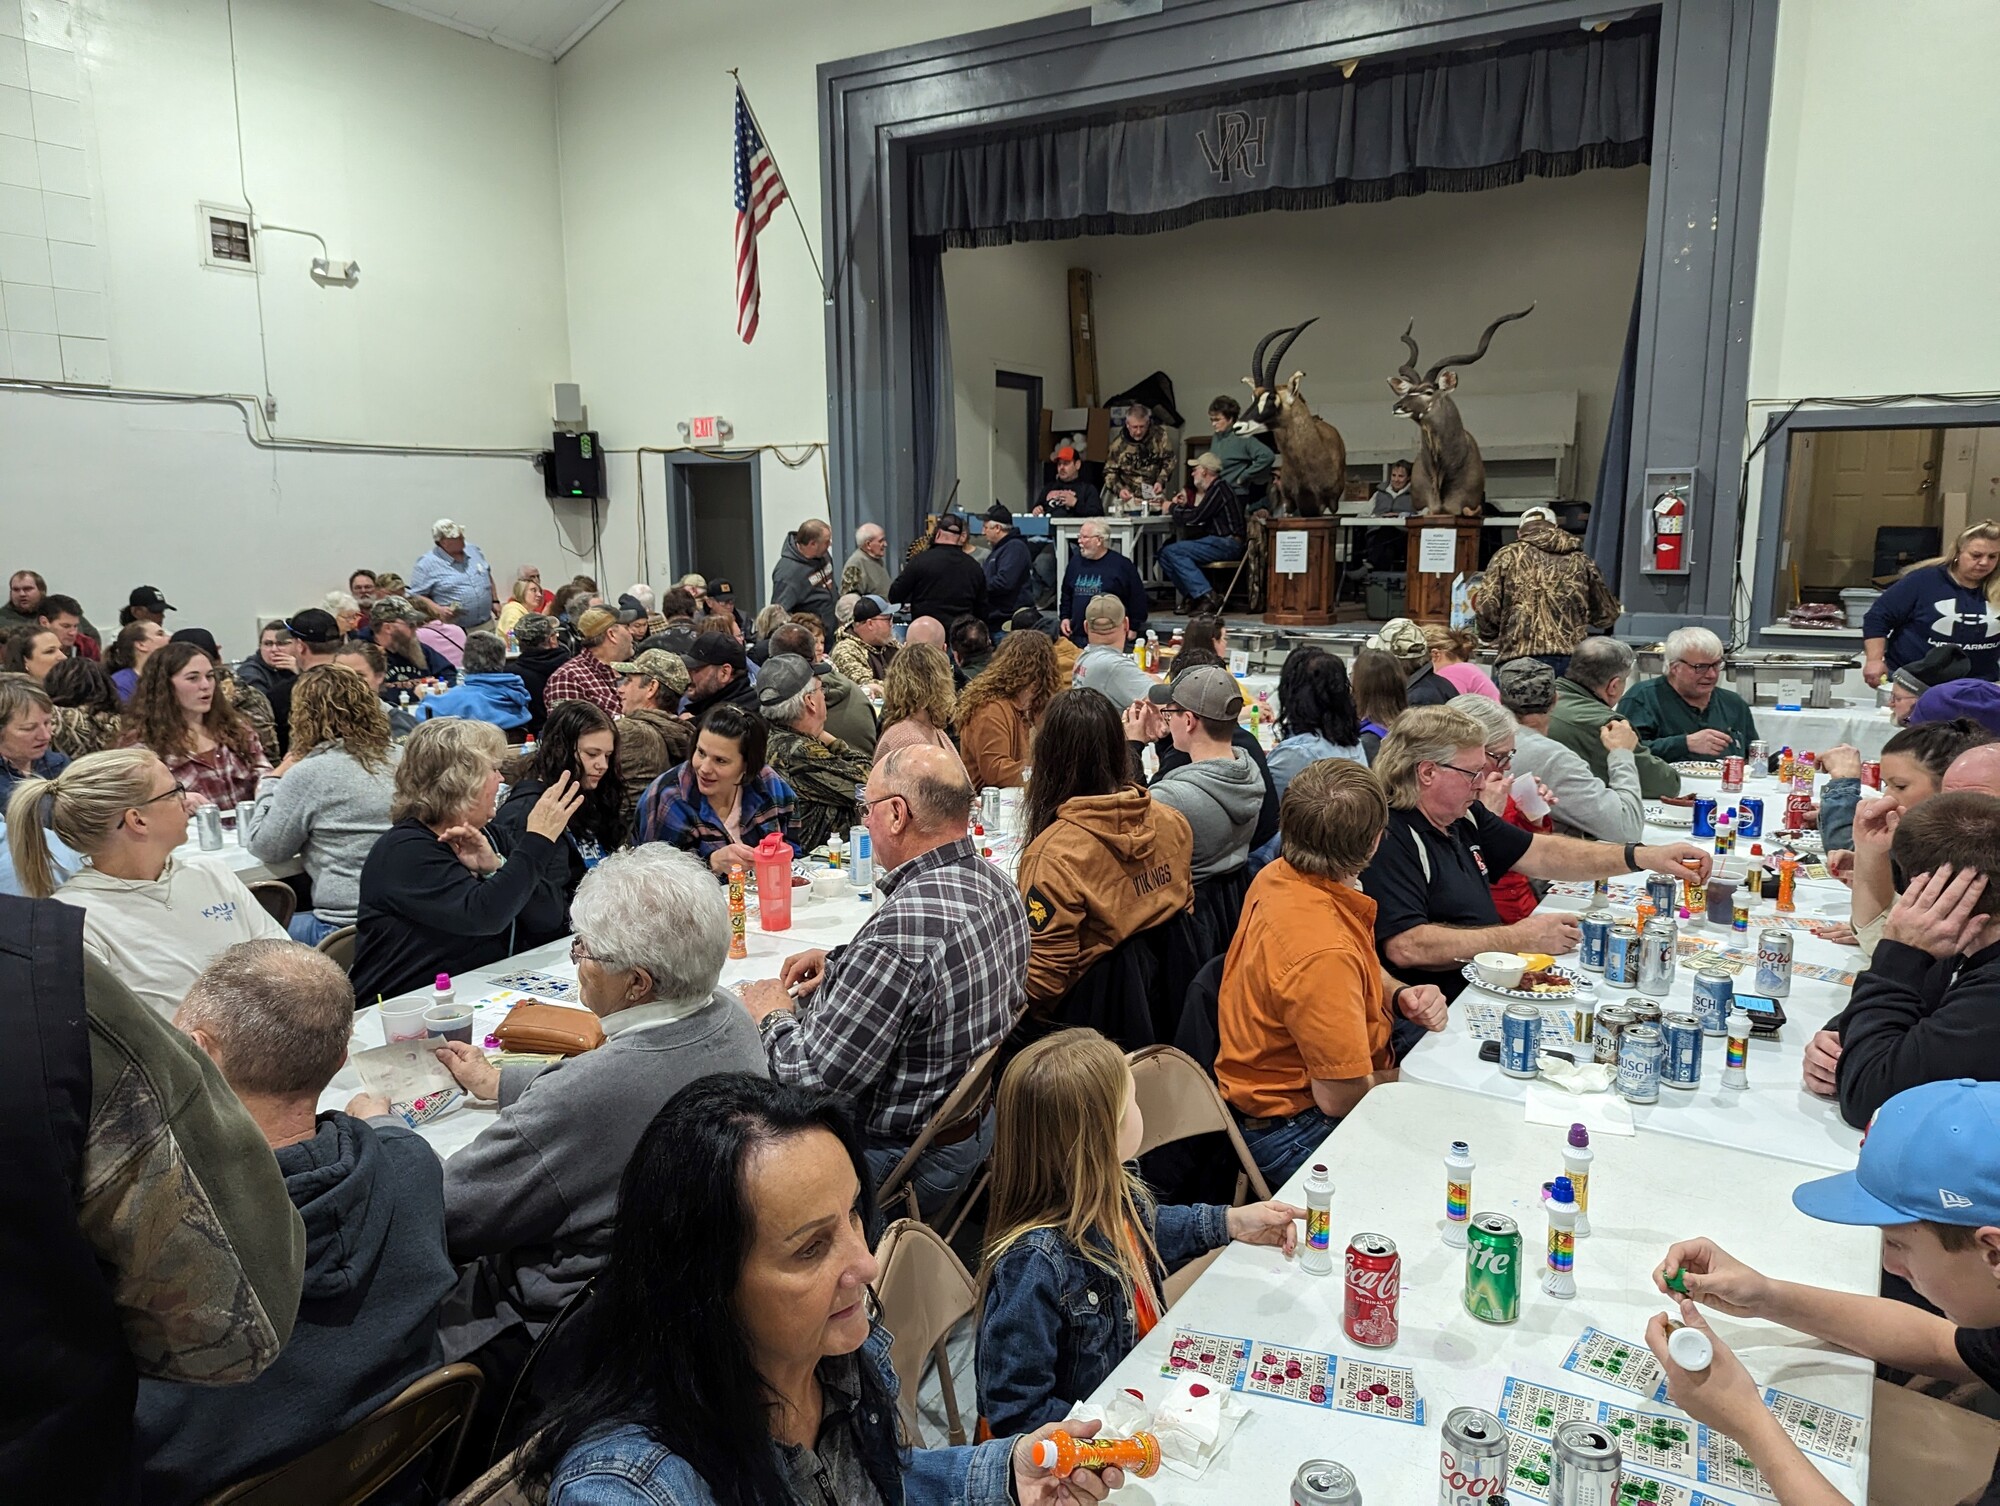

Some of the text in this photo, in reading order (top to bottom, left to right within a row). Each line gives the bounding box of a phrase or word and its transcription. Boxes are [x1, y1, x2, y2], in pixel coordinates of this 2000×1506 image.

[694, 417, 714, 438] EXIT
[201, 901, 236, 918] KAUI
[1355, 1296, 1384, 1306] ORIGINAL
